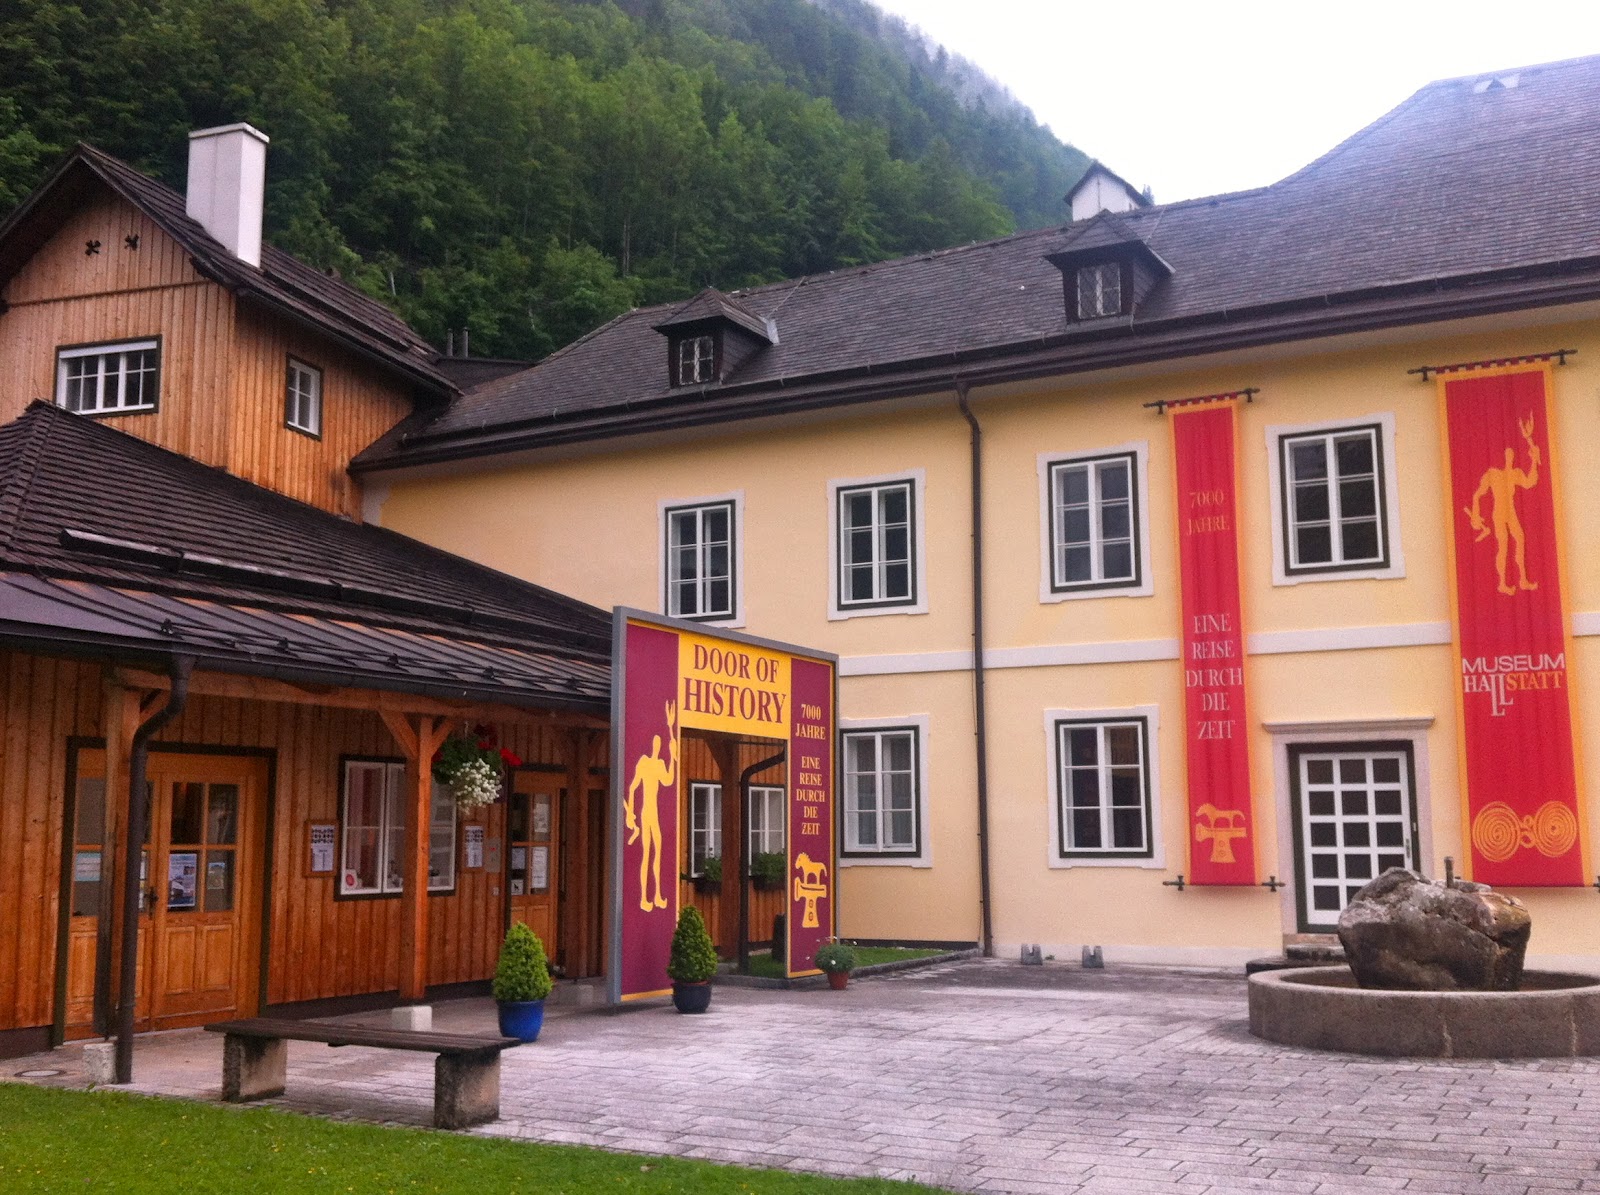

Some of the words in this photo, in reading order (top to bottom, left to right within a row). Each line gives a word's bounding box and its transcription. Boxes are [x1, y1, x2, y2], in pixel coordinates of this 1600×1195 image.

[1187, 489, 1224, 508] 7000
[1187, 515, 1230, 536] JAHRE
[1194, 613, 1231, 634] EINE
[1192, 640, 1234, 660] REISE
[693, 643, 751, 680] DOOR
[756, 656, 780, 684] OF
[1461, 652, 1566, 674] MUSEUM
[1186, 667, 1244, 687] DURCH
[683, 677, 787, 724] HISTORY
[1202, 692, 1230, 712] DIE
[801, 703, 822, 721] 7000
[795, 723, 826, 740] JAHRE
[1198, 720, 1236, 740] ZEIT
[801, 756, 821, 770] EINE
[799, 772, 822, 786] REISE
[796, 788, 825, 803] DURCH
[803, 805, 818, 819] DIE
[801, 822, 821, 836] ZEIT
